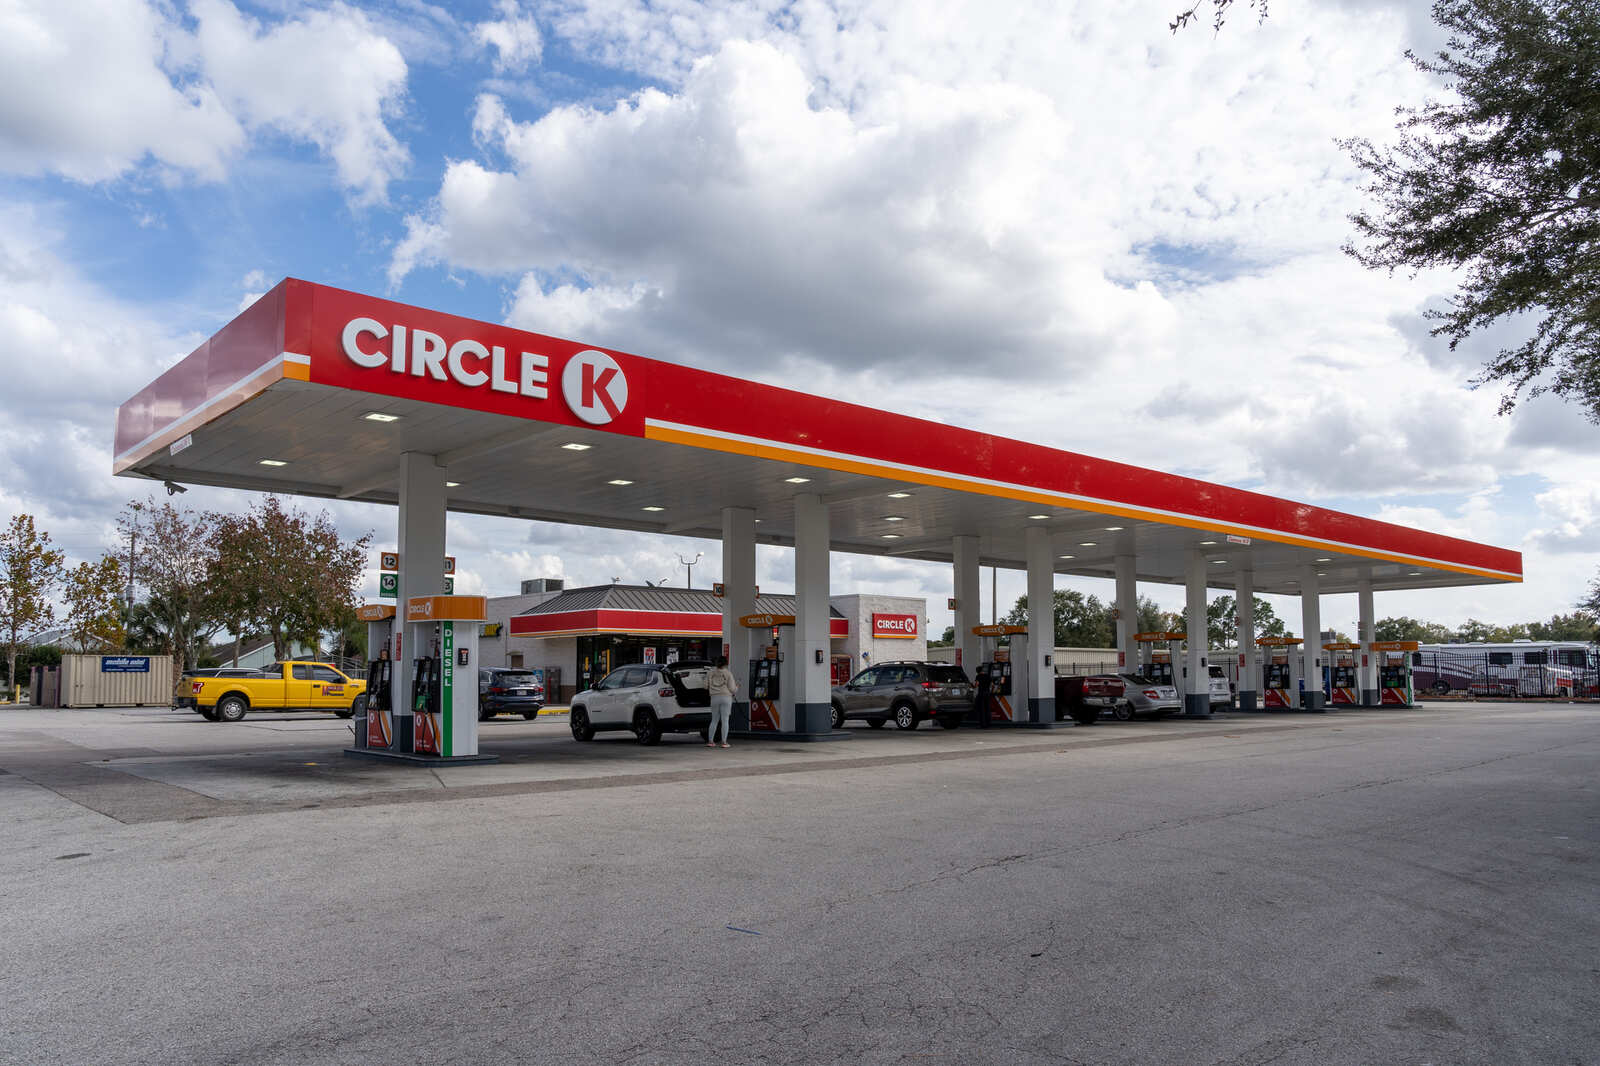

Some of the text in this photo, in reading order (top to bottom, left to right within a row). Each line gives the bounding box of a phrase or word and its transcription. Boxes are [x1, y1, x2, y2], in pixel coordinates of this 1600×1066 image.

[341, 317, 624, 422] CIRCLE K
[385, 556, 396, 566] 12
[384, 577, 395, 587] 14
[877, 618, 915, 632] CIRCLE K
[444, 628, 453, 687] DIESEL
